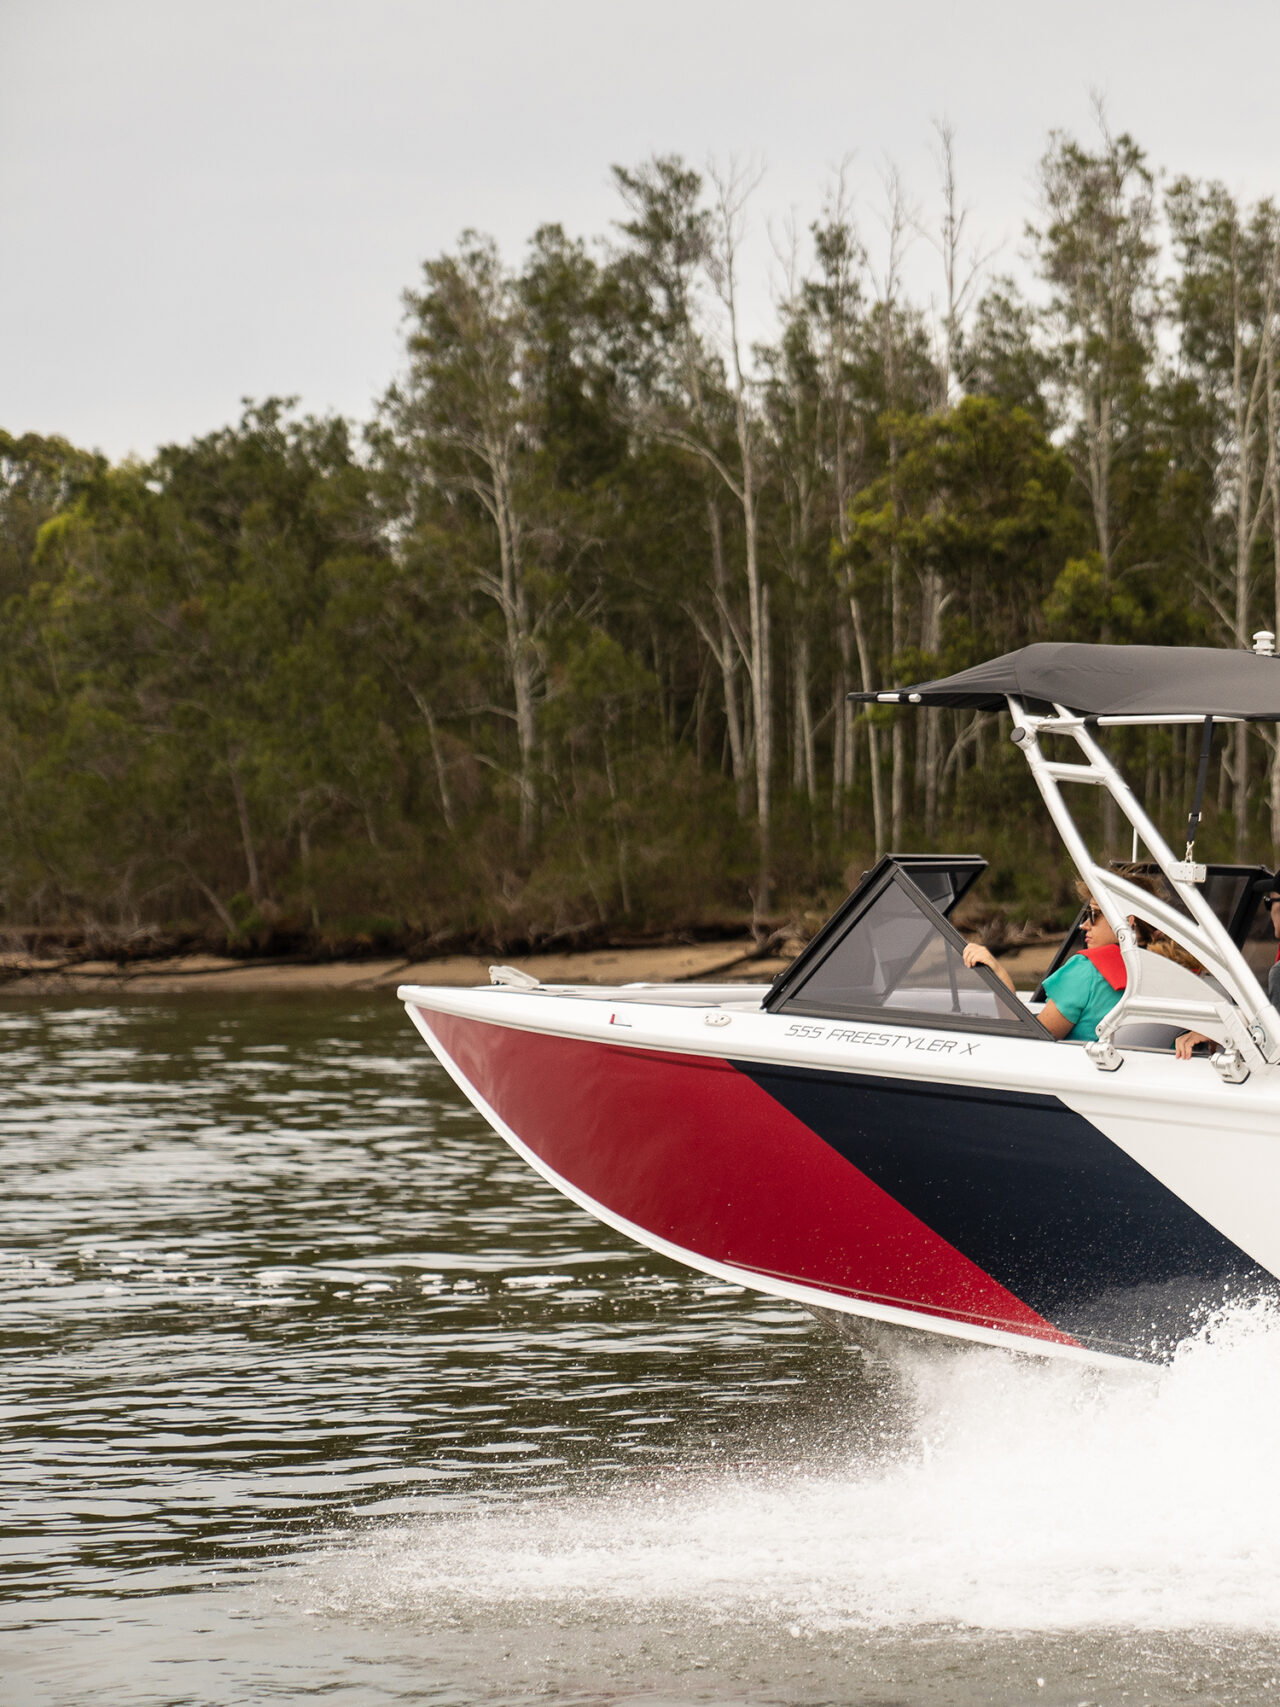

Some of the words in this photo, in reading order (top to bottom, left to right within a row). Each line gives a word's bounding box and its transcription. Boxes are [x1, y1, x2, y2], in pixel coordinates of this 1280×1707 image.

[784, 1024, 825, 1039] 555
[826, 1028, 958, 1053] FREESTYLER
[959, 1042, 981, 1056] X
